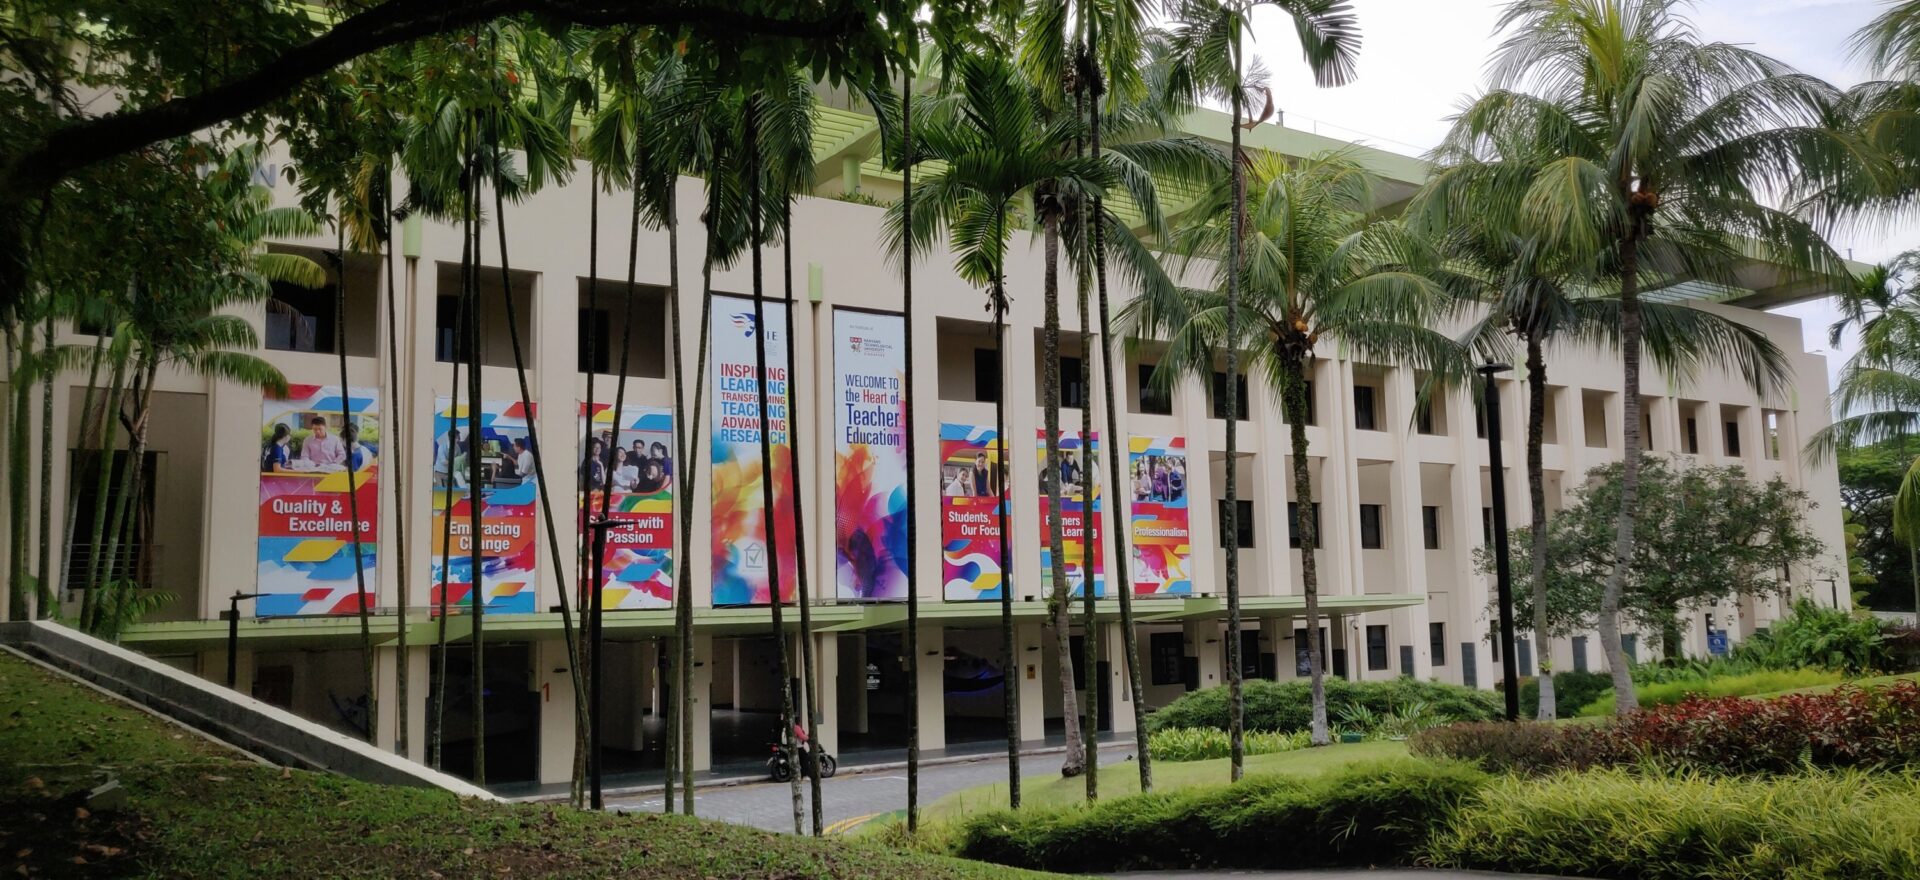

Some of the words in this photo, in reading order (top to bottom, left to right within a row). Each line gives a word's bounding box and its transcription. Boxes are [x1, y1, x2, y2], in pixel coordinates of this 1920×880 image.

[721, 363, 785, 381] INSPING
[721, 377, 785, 395] LEARNG
[845, 374, 887, 389] WELCOME
[888, 377, 899, 390] TO
[721, 392, 786, 405] TRANSFOMING
[845, 387, 860, 402] the
[863, 388, 887, 404] Heart
[890, 391, 899, 405] of
[721, 401, 786, 419] TEACHNG
[845, 403, 899, 428] Teacher
[721, 416, 786, 432] ADVANING
[721, 428, 786, 444] RESEACH
[846, 426, 900, 446] Education
[272, 498, 327, 516] Quality
[331, 500, 342, 514] &
[289, 517, 370, 532] Excellene
[638, 516, 664, 529] with
[948, 511, 991, 524] Students,
[450, 521, 520, 538] Emacing
[606, 530, 653, 543] Passion
[961, 524, 977, 535] Our
[979, 525, 1001, 536] Focu
[1061, 527, 1098, 539] Learng
[1134, 527, 1188, 537] Professionalism
[542, 682, 550, 703] 1
